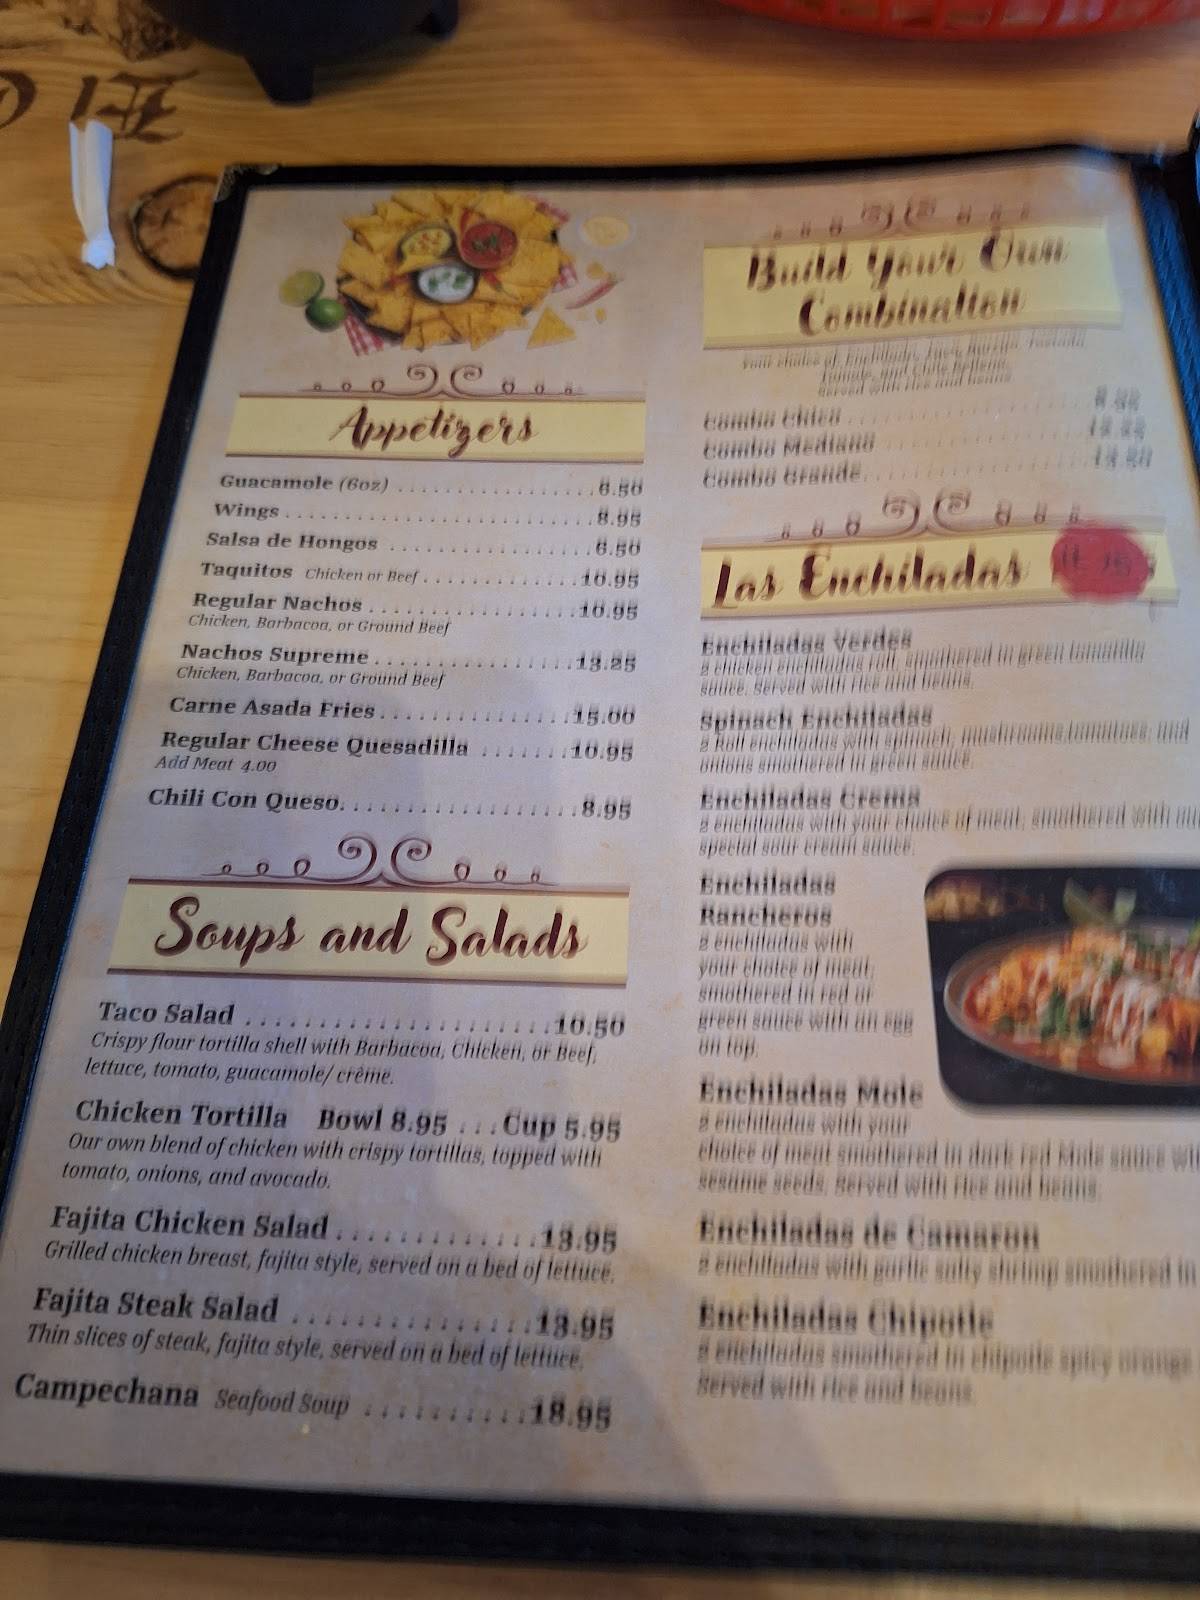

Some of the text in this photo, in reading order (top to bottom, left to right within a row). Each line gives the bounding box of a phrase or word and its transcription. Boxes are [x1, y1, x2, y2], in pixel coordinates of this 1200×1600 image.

[329, 403, 539, 458] Appetizers
[220, 475, 333, 490] Guacamole
[339, 477, 389, 494] (6oz)
[214, 503, 279, 521] Wings
[206, 532, 260, 547] Salsa
[267, 533, 292, 548] de
[300, 535, 378, 553] Hongos
[201, 562, 293, 579] Taquitos
[305, 567, 363, 582] Chicken
[367, 571, 383, 582] or
[387, 569, 419, 585] Beef
[192, 592, 277, 611] Regular
[283, 595, 362, 612] Nachos
[189, 614, 451, 637] Chicken, Barbacoa, or Ground Beef
[181, 644, 262, 661] Nachos
[269, 647, 369, 666] Supreme
[176, 666, 446, 689] Chicken, Barbacoa, or Ground Beef
[170, 697, 236, 714] Carne
[242, 699, 311, 717] Asada
[319, 702, 375, 719] Fries
[160, 731, 251, 752] Regular
[257, 733, 339, 753] Cheese
[346, 735, 468, 758] Quesadilla
[154, 756, 277, 774] Add Meat 4.00
[148, 788, 204, 807] Chili
[211, 790, 257, 809] Con
[265, 792, 339, 813] Queso
[154, 895, 589, 969] Soups and Salads
[99, 1001, 157, 1022] Taco
[164, 1003, 235, 1026] Salad
[91, 1032, 148, 1051] Crispy
[149, 1032, 196, 1054] flour
[199, 1034, 260, 1053] tortilla
[265, 1036, 307, 1055] shell
[311, 1039, 351, 1056] with
[84, 1057, 147, 1079] lettuce,
[153, 1059, 220, 1081] tomato,
[75, 1100, 182, 1125] Chicken
[190, 1103, 287, 1128] Tortilla
[317, 1105, 383, 1131] Bowl
[390, 1107, 448, 1136] 8.95
[503, 1109, 556, 1141] Cup
[68, 1131, 103, 1150] Our
[107, 1136, 145, 1152] own
[149, 1134, 202, 1155] blend
[205, 1137, 229, 1160] of
[229, 1138, 298, 1158] chicken
[303, 1140, 343, 1160] with
[348, 1140, 404, 1165] crispy
[61, 1161, 331, 1190] tomato, onions, and avocado.
[50, 1205, 126, 1234] Fajita
[135, 1208, 245, 1236] Chicken
[252, 1212, 328, 1241] Salad
[45, 1240, 109, 1262] Grilled
[111, 1242, 183, 1265] chicken
[187, 1246, 251, 1271] breast,
[256, 1249, 310, 1274] fajita
[368, 1255, 431, 1276] served
[436, 1259, 460, 1277] on
[465, 1261, 478, 1277] a
[482, 1257, 518, 1279] bed
[523, 1259, 545, 1284] of
[32, 1286, 110, 1318] Fajita
[117, 1290, 193, 1319] Steak
[201, 1294, 279, 1323] Salad
[27, 1322, 71, 1344] Thin
[74, 1324, 127, 1348] slices
[132, 1327, 156, 1354] of
[157, 1329, 211, 1355] steak,
[216, 1331, 270, 1358] fajita
[332, 1339, 396, 1362] served
[400, 1343, 425, 1364] on
[448, 1341, 484, 1365] bed
[15, 1372, 200, 1408] Campechana
[214, 1387, 297, 1416] Seafood
[298, 1391, 350, 1421] Soup
